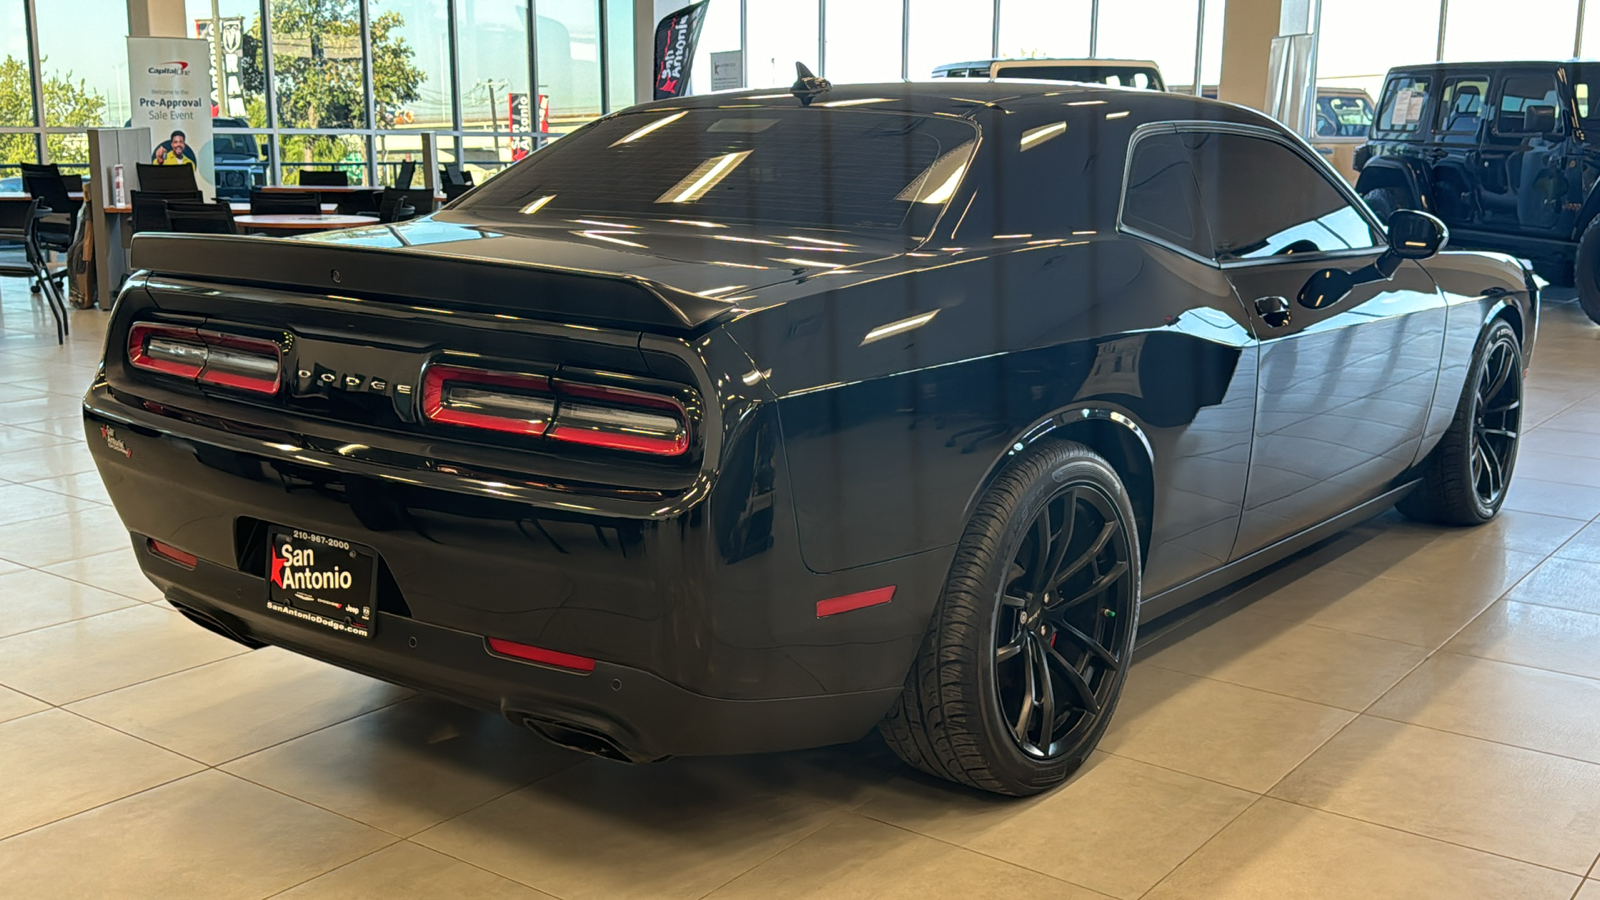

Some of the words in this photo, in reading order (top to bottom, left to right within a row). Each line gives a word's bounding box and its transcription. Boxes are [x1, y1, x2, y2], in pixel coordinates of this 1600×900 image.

[139, 97, 202, 109] Pre-Approval
[148, 110, 168, 120] Sale
[170, 110, 194, 120] Event
[298, 369, 411, 394] DODGE
[293, 530, 350, 550] 210-967-2000
[281, 543, 314, 567] San
[282, 566, 352, 590] Antonio
[266, 601, 368, 637] SanAntonioDodge.com
